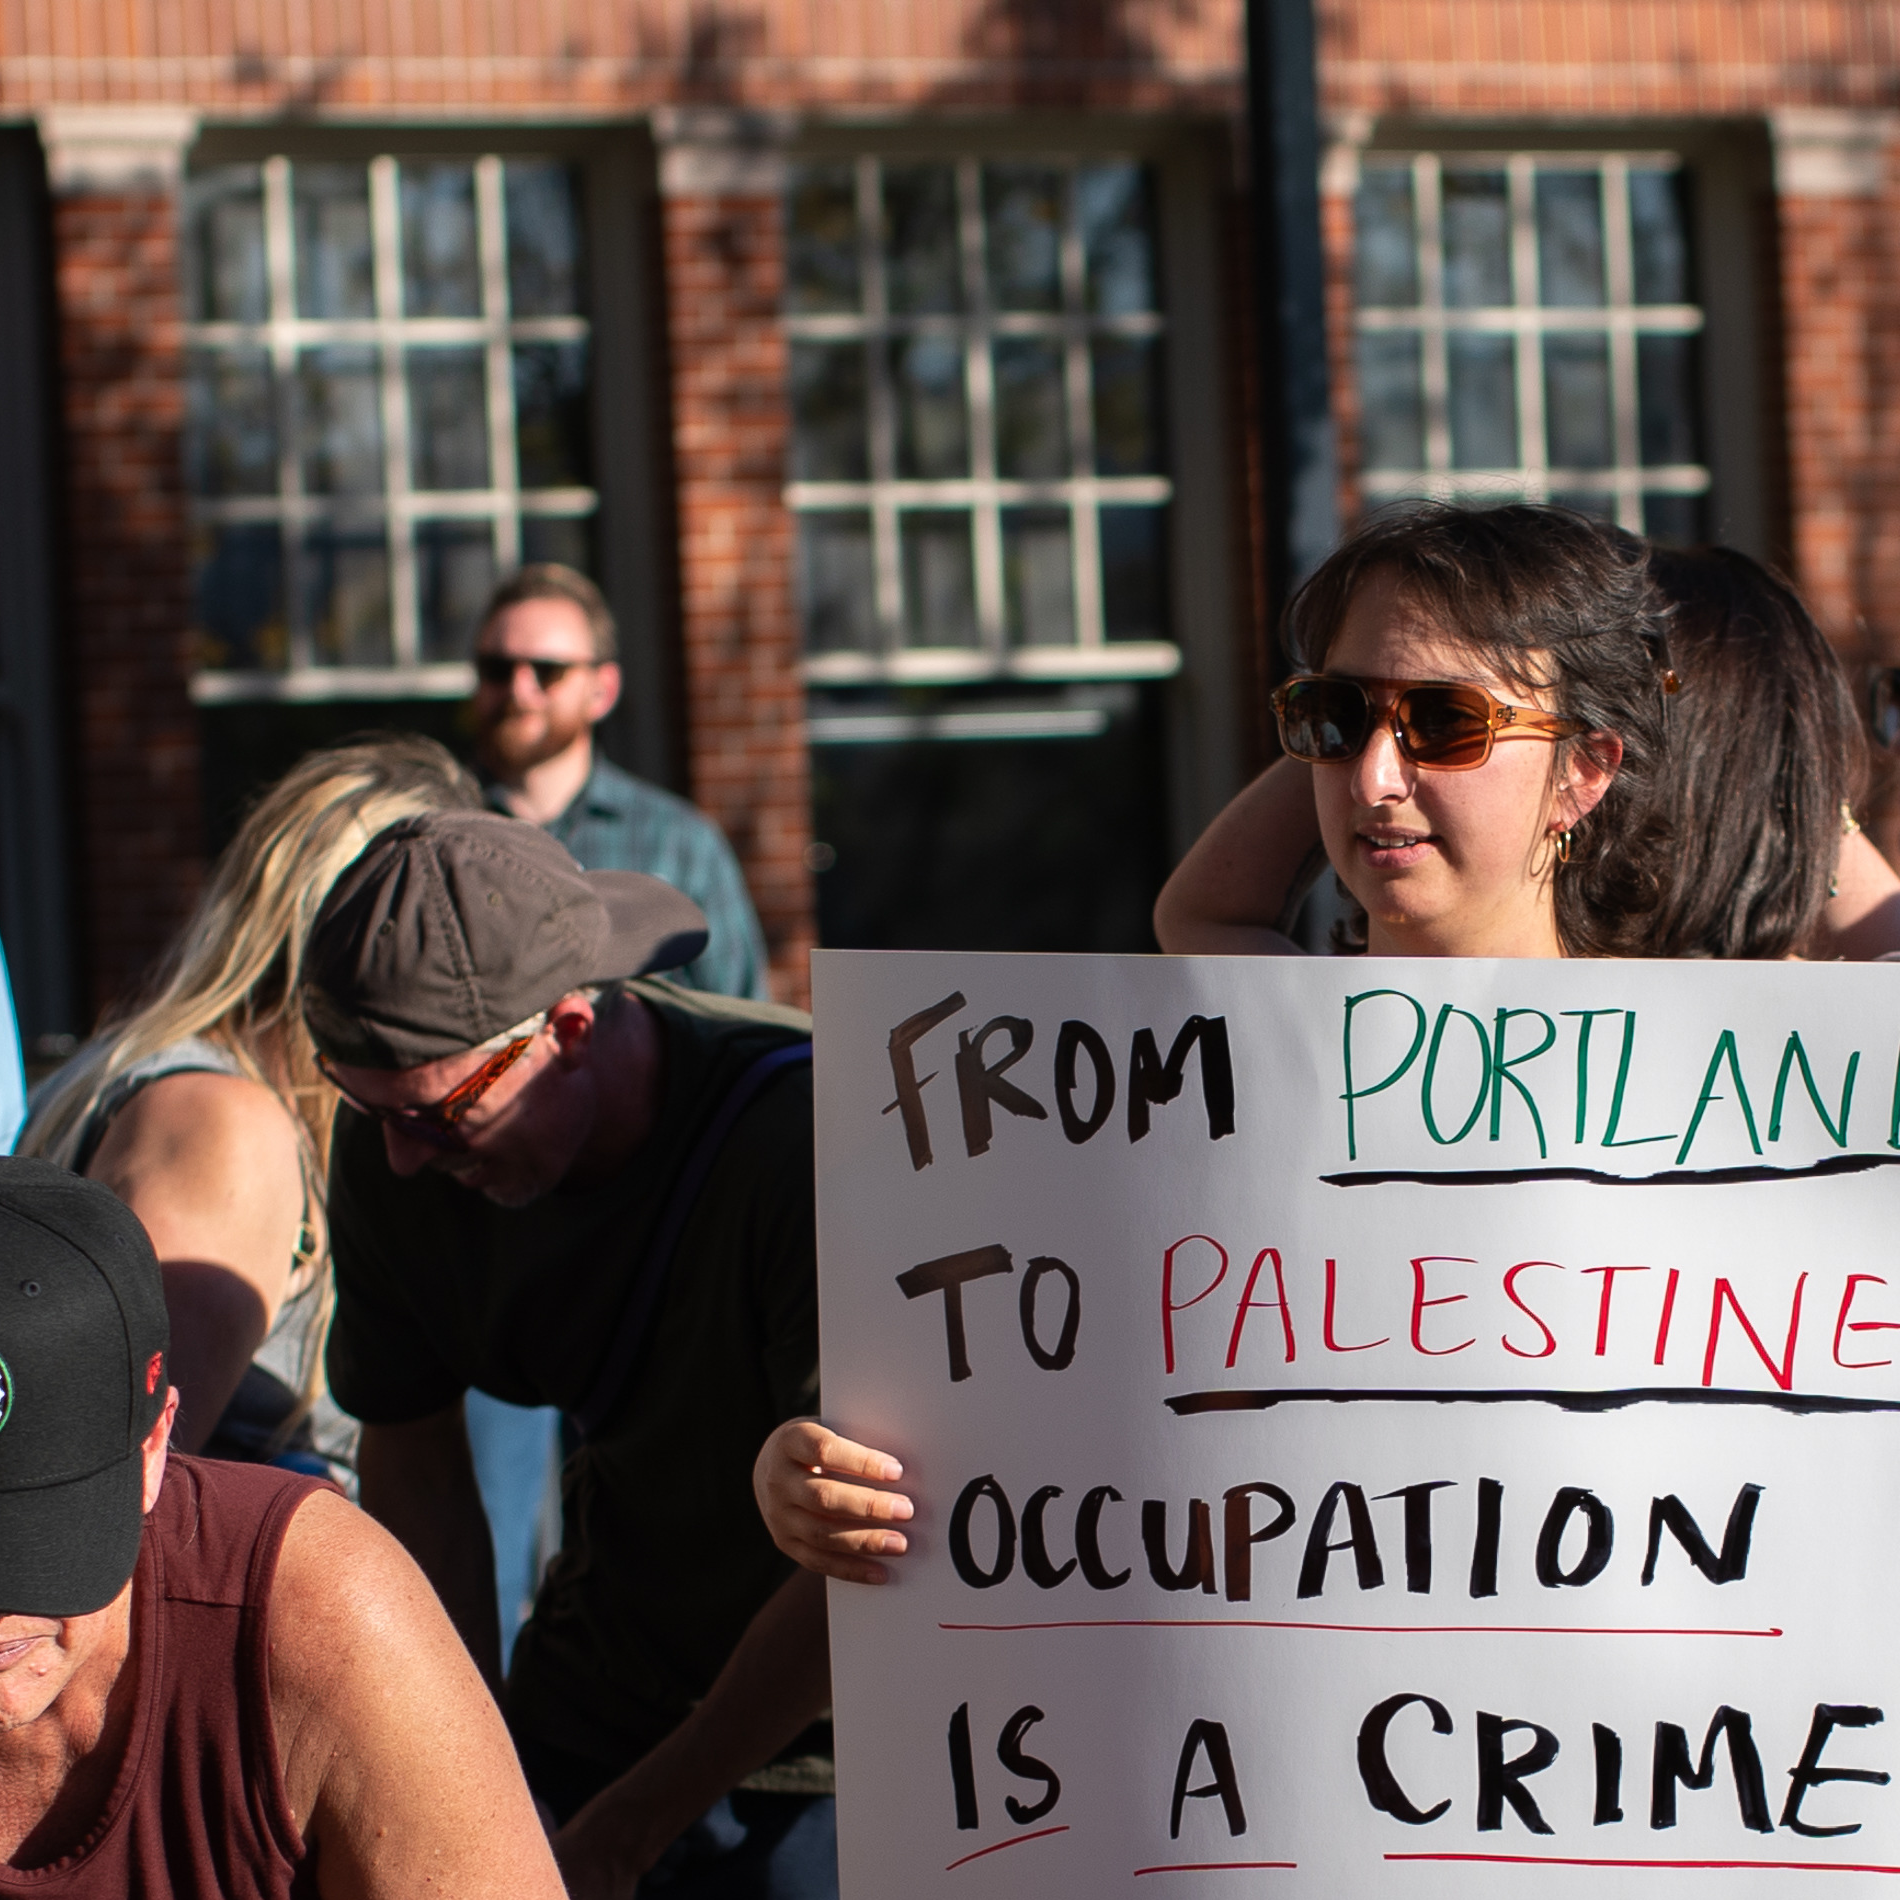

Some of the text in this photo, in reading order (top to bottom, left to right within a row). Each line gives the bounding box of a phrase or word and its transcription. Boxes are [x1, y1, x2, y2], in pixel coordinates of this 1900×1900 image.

[883, 991, 1236, 1170] FROM
[897, 1244, 1081, 1382] TO
[948, 1474, 1766, 1602] OCCUPATION
[948, 1701, 1064, 1832] IS
[1171, 1718, 1248, 1839] A
